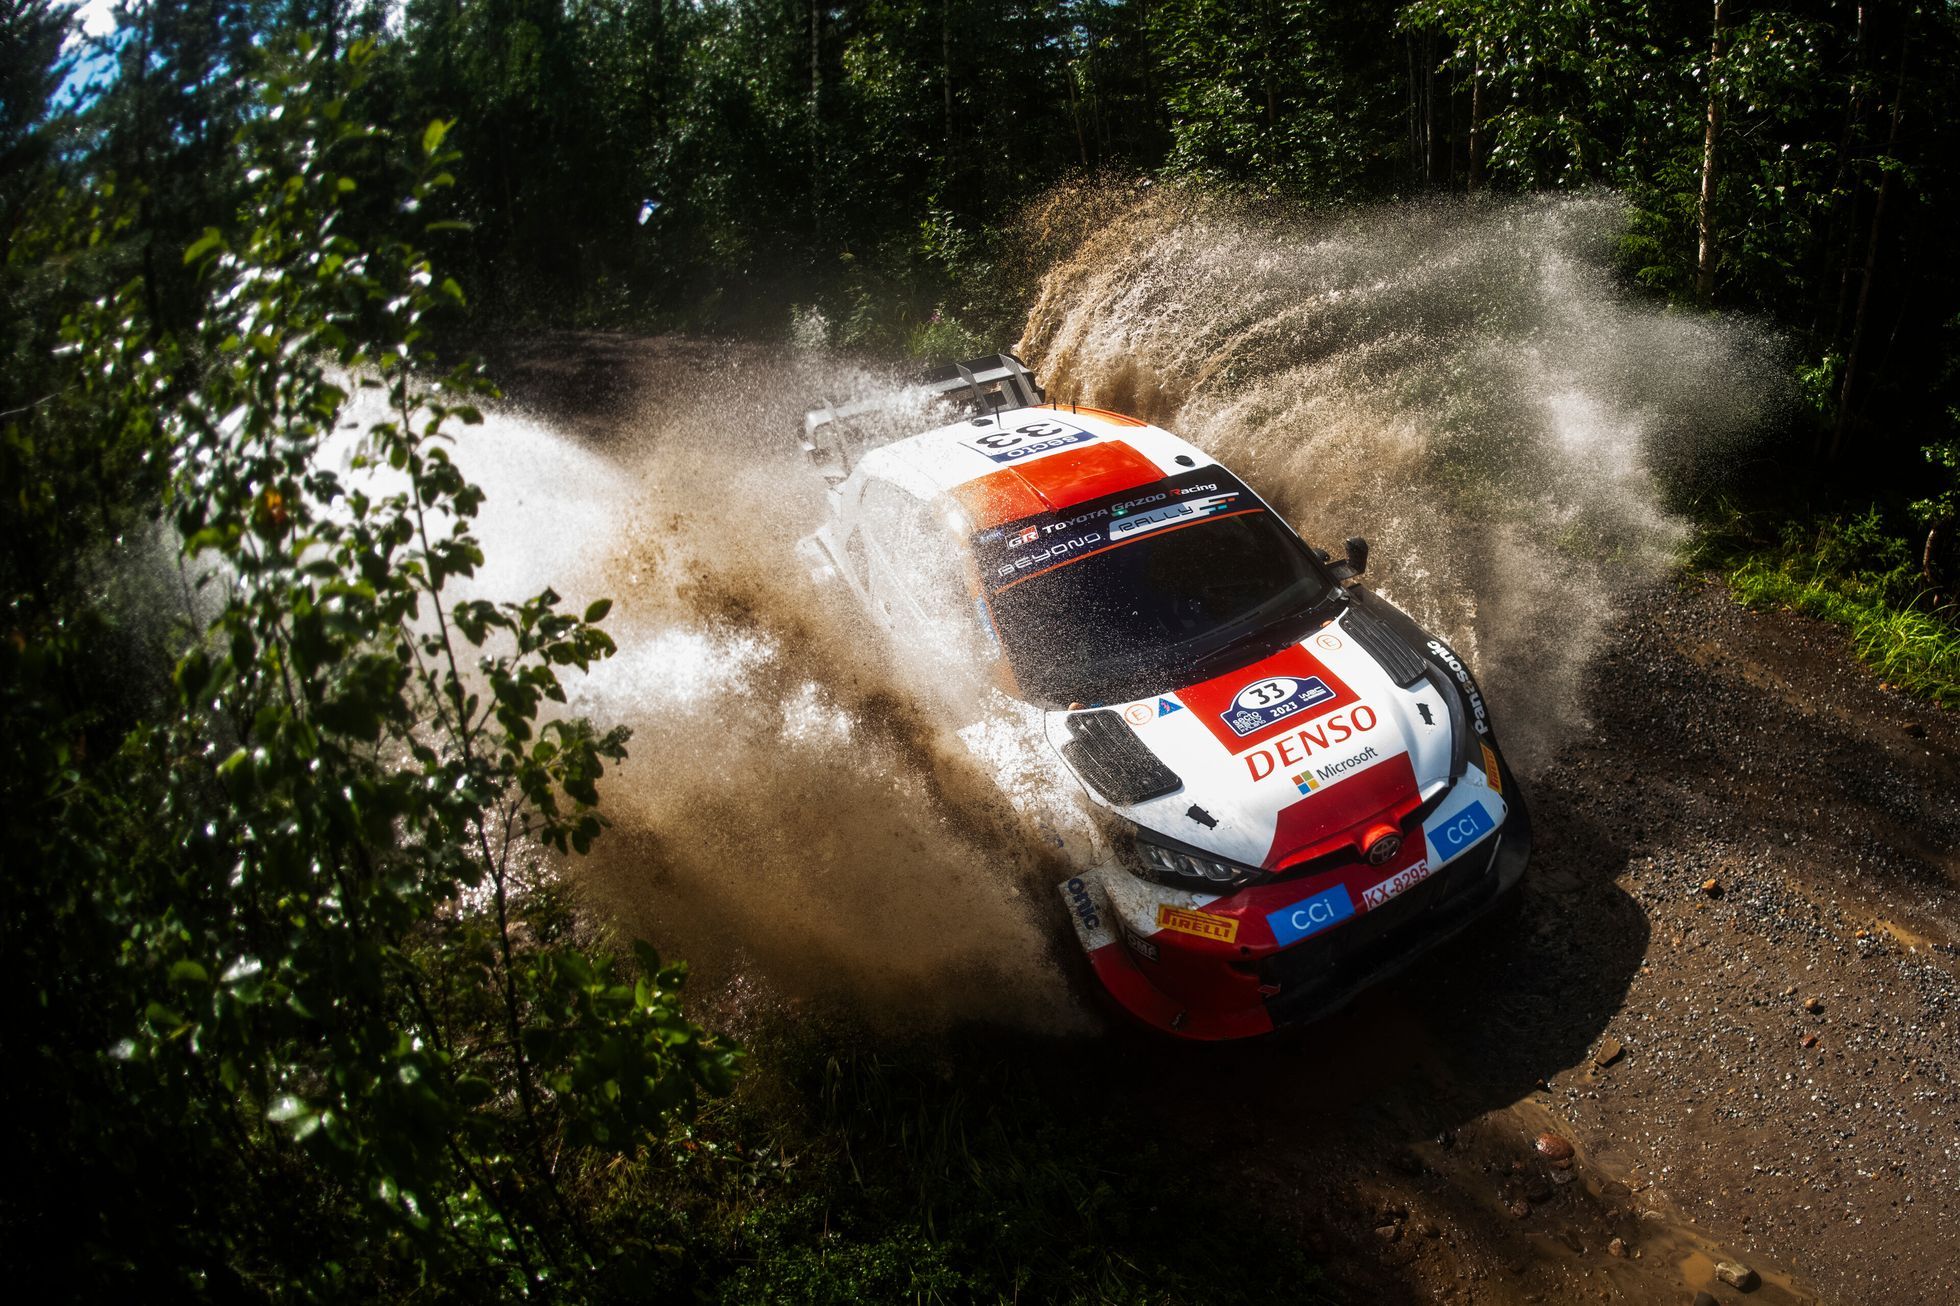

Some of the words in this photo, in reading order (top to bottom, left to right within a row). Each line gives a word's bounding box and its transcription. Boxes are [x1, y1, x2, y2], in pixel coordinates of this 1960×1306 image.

[976, 423, 1062, 449] 33
[1007, 435, 1079, 458] secto
[1170, 481, 1217, 496] Racing
[998, 532, 1101, 576] BEYOND
[1119, 505, 1193, 533] RALLY
[1249, 682, 1285, 705] 33
[1427, 640, 1488, 735] Panasonic
[1270, 702, 1298, 717] 2023
[1244, 706, 1378, 783] DENSO
[1315, 745, 1379, 781] Microsoft
[1365, 862, 1430, 908] KX-8295
[1162, 908, 1232, 939] PIRELLI
